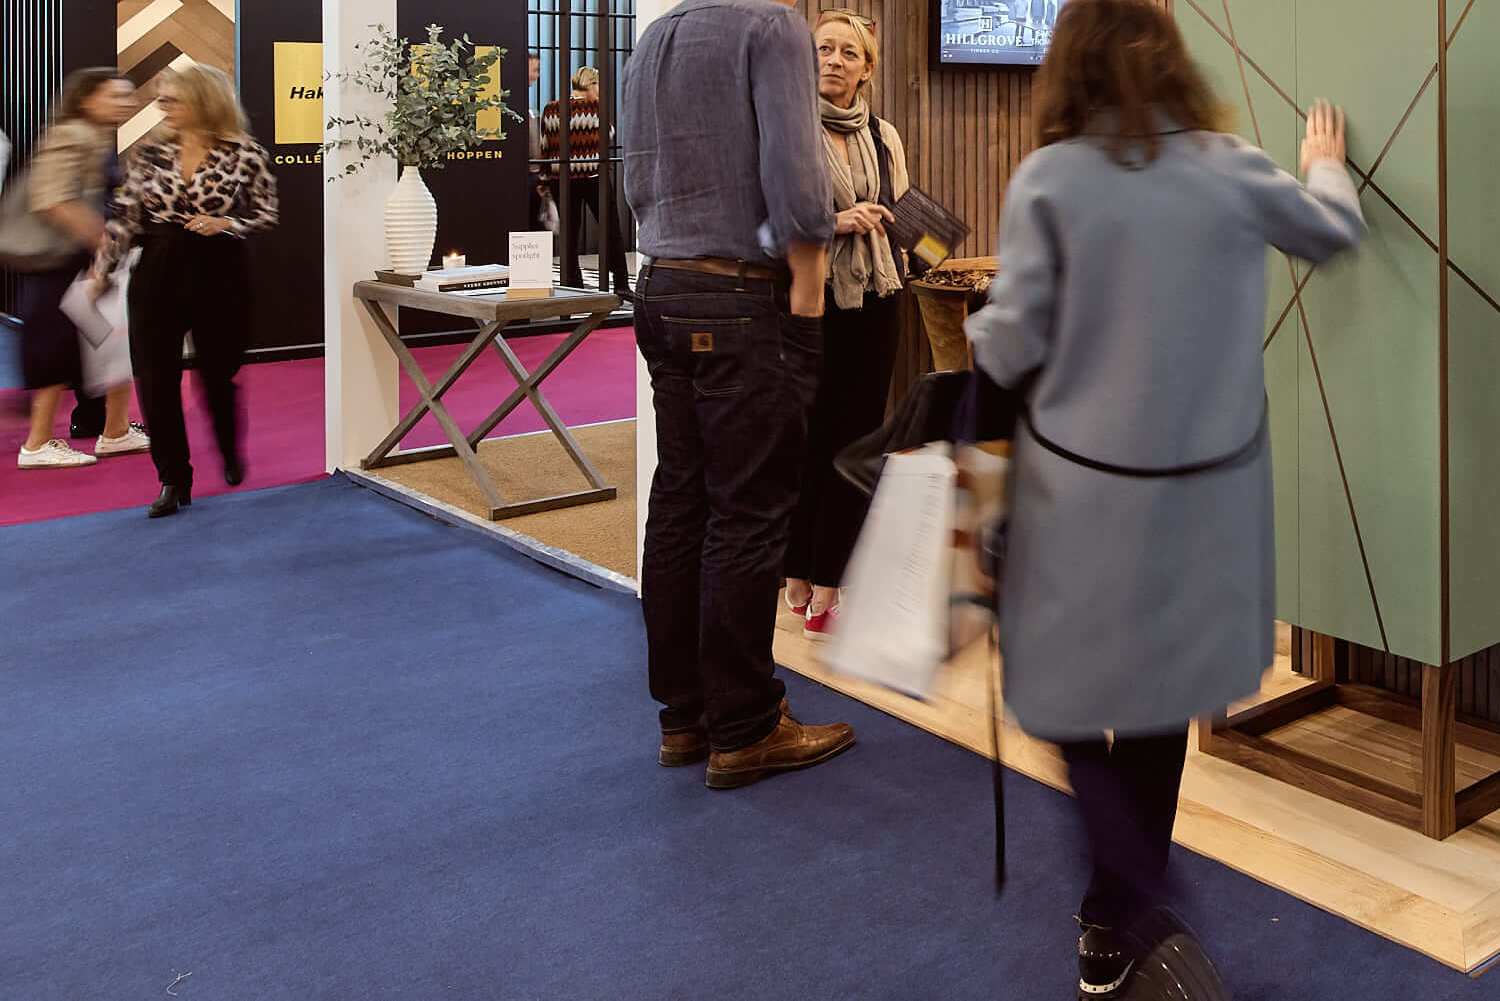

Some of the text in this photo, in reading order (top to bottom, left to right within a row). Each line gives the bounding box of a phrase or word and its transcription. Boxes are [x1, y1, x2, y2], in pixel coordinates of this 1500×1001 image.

[946, 33, 1023, 47] HILLGROVE
[290, 86, 323, 100] Hak
[275, 154, 321, 165] COLLE
[447, 150, 502, 160] HOPPEN
